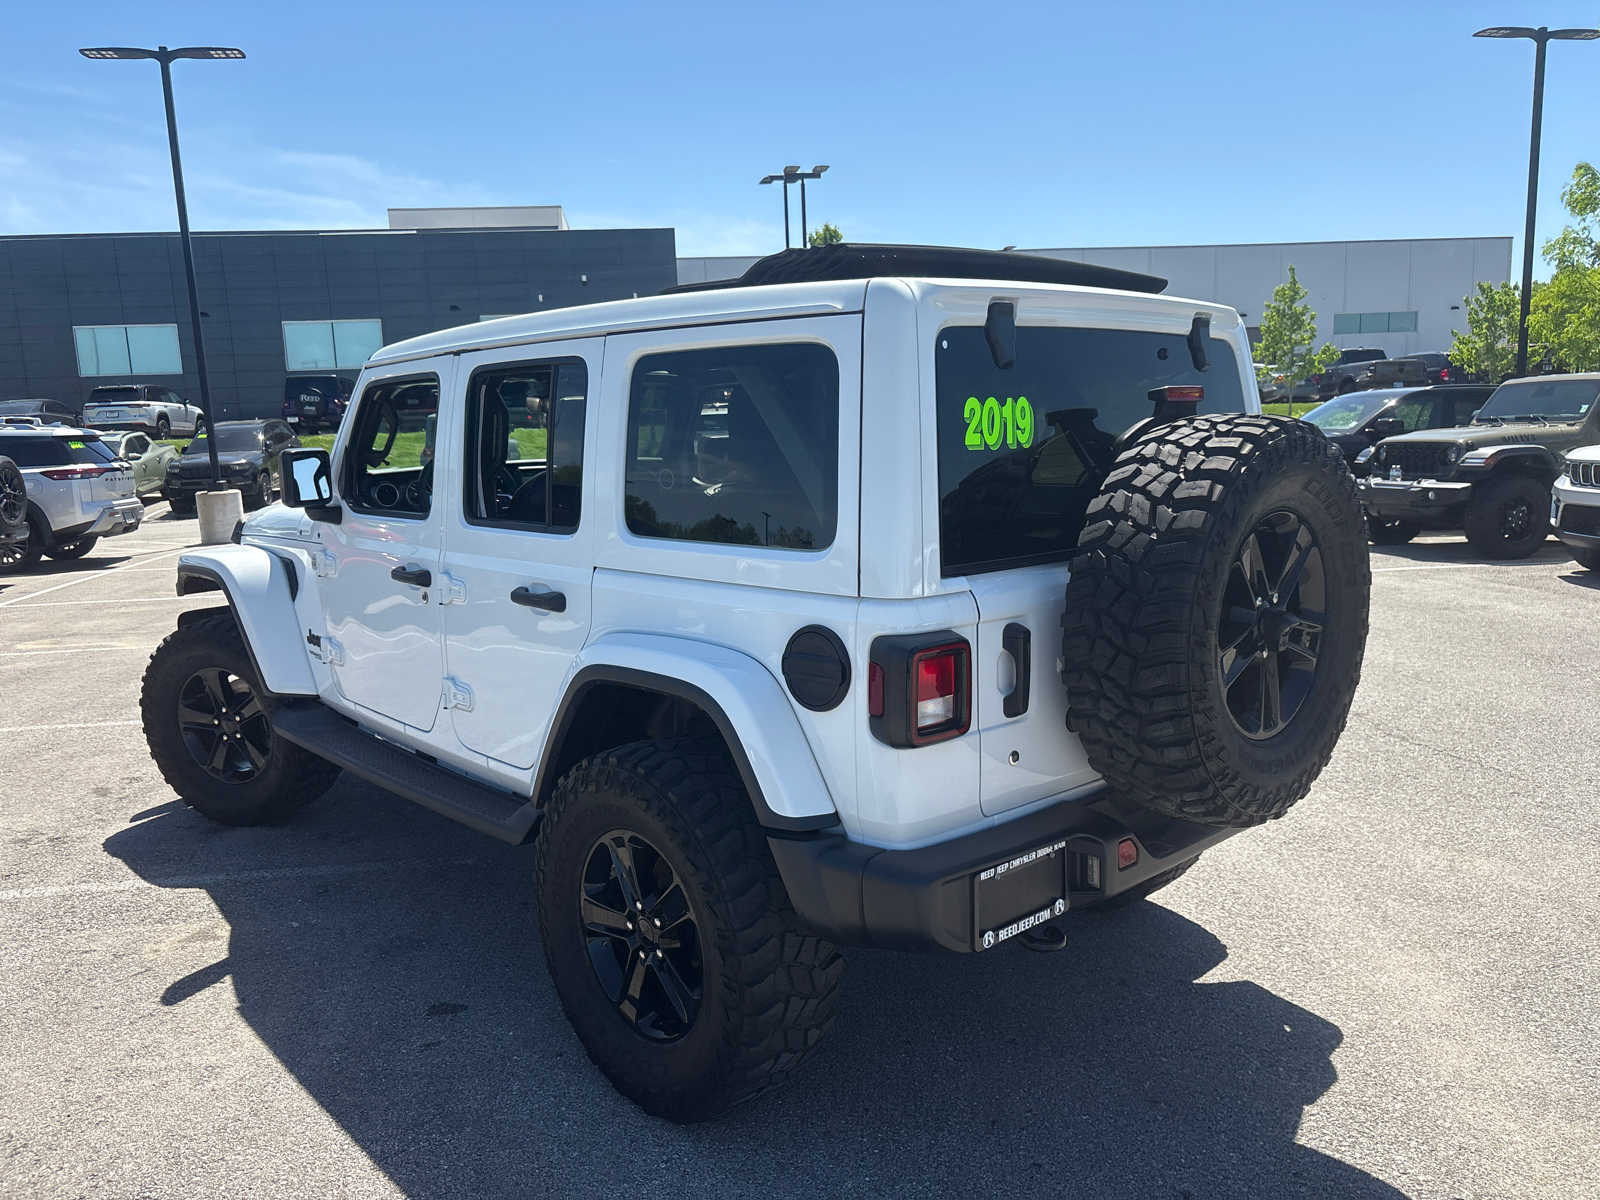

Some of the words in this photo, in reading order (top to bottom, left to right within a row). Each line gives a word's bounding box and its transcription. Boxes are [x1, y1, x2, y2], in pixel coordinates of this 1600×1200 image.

[300, 394, 320, 402] REED
[964, 396, 1034, 451] 2019
[1500, 433, 1537, 444] WILLYS
[980, 868, 994, 880] REED
[996, 862, 1009, 874] JEEP
[1010, 852, 1036, 868] CHRYSLER
[1037, 846, 1053, 858] DODGE
[1053, 841, 1066, 851] RAM
[999, 909, 1050, 941] REEDJEEP.COM
